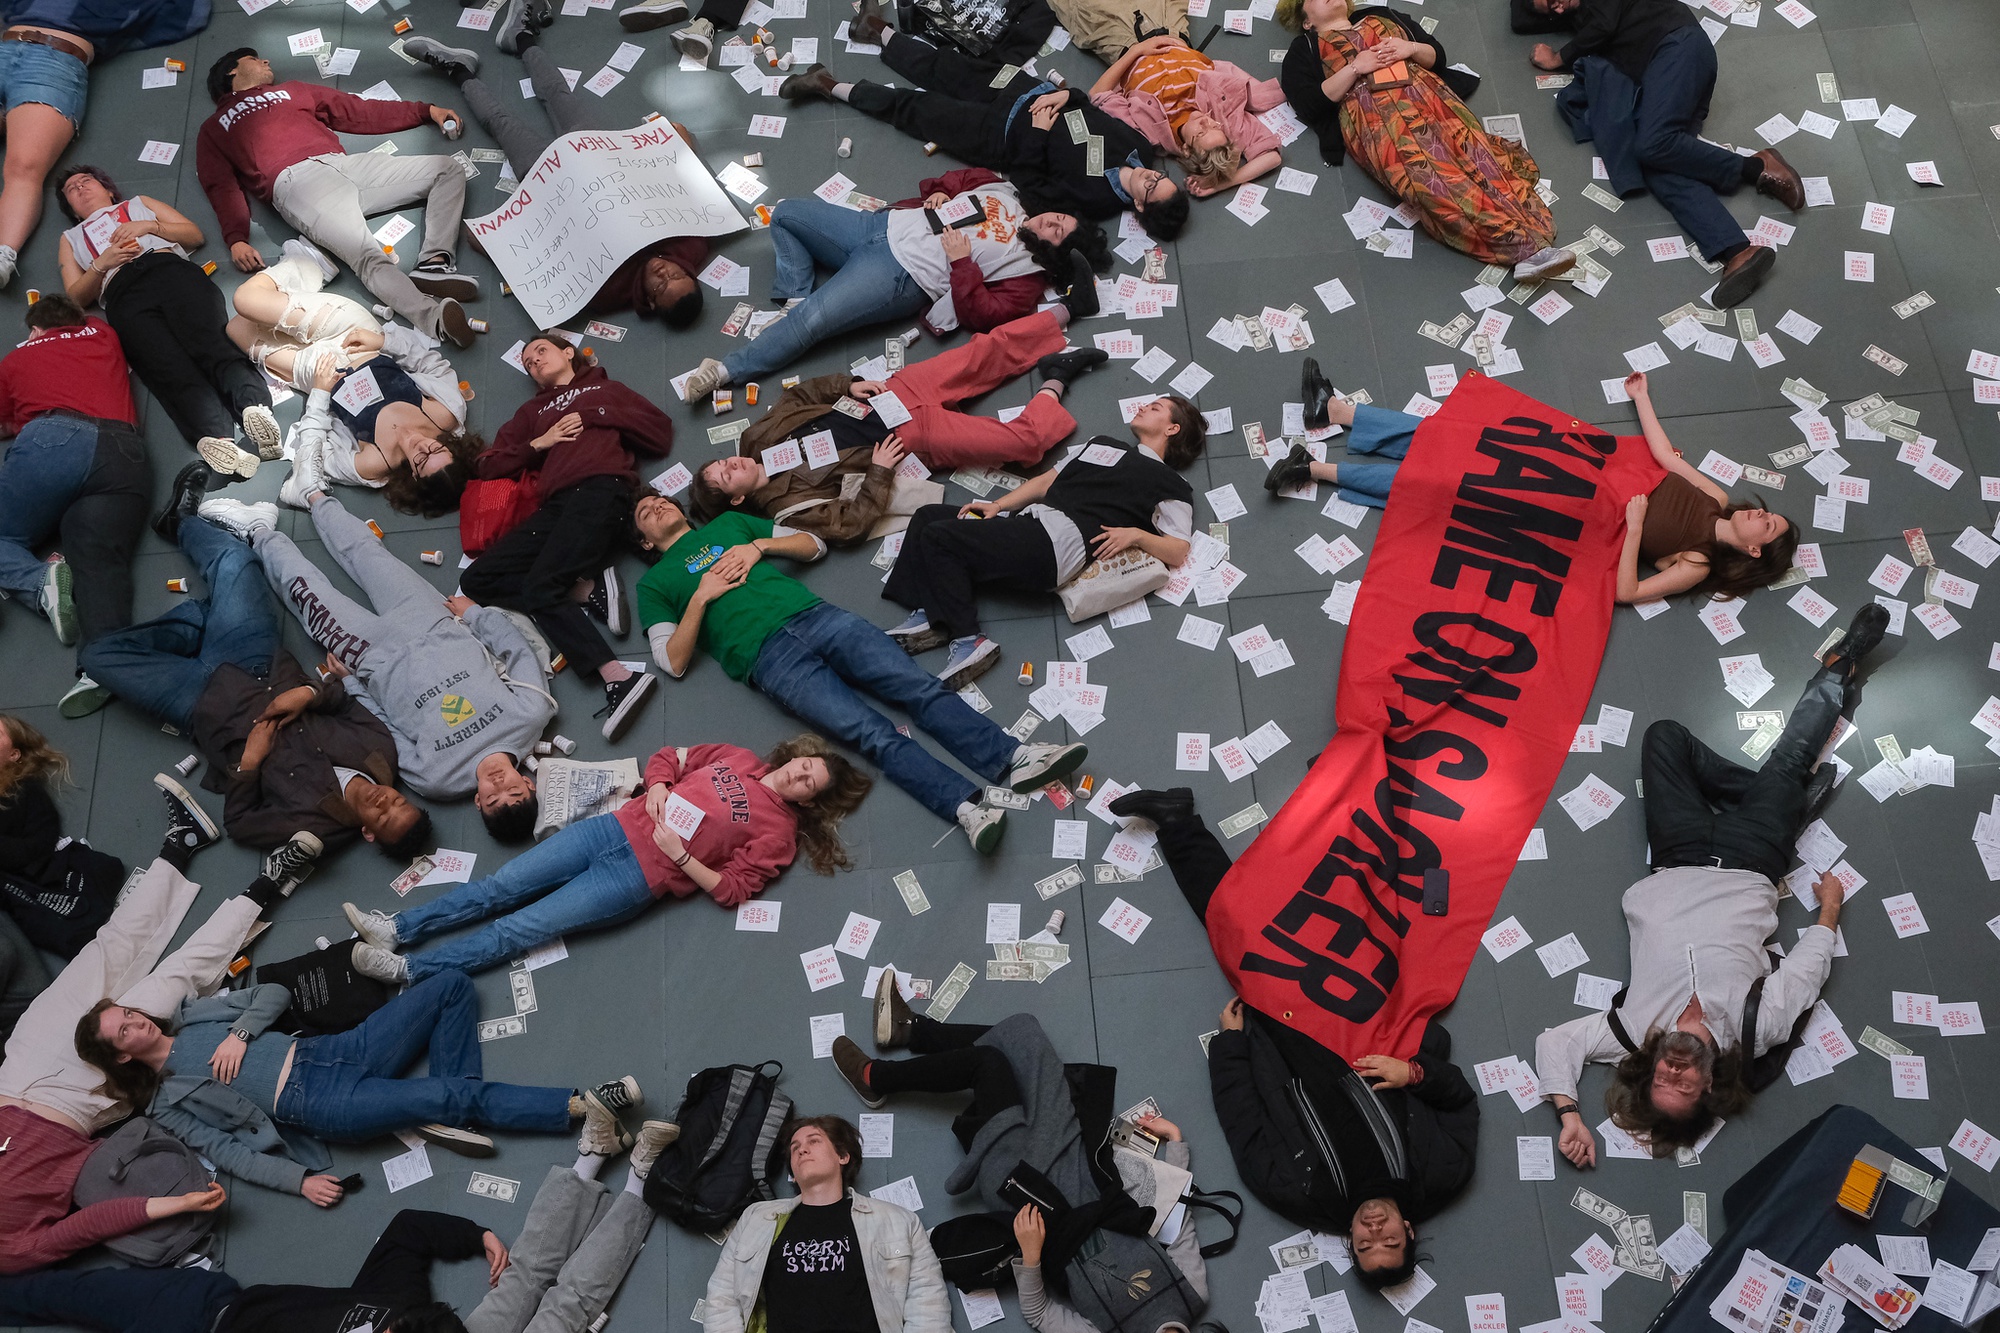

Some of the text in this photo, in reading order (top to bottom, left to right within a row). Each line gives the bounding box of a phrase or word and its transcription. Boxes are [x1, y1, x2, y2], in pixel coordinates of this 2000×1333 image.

[219, 90, 291, 132] HARVARD
[607, 151, 678, 168] AGASSIZ
[474, 127, 673, 236] TAKE THEM ALL DOWN!
[582, 171, 626, 203] ELIOT
[584, 183, 688, 230] WINTHROP
[509, 177, 575, 257] GRIFFIN
[629, 204, 725, 228] SACKLER
[524, 218, 576, 275] LEVERETT
[517, 251, 575, 292] LOWELL
[532, 242, 615, 315] MATHER
[812, 442, 829, 450] DOWN
[813, 446, 830, 454] THEIR
[772, 453, 780, 466] NAME
[782, 448, 790, 464] DOWN
[816, 450, 830, 458] NAME
[290, 576, 370, 670] HARVARD
[1385, 611, 1540, 729] ON
[414, 684, 442, 710] 1930
[434, 703, 504, 752] LEVERETT
[1221, 745, 1236, 755] TAKE
[1223, 749, 1240, 761] DOWN
[1225, 753, 1242, 764] THEIR
[1230, 759, 1245, 769] NAME
[711, 761, 750, 822] ASTINE
[668, 806, 681, 822] NAME
[674, 810, 686, 826] THEIR
[678, 812, 691, 828] DOWN
[684, 818, 696, 830] TAKE
[1111, 906, 1131, 929] SACKLER
[1889, 905, 1916, 916] SACKLER
[1123, 918, 1132, 926] ON
[1127, 918, 1143, 935] SHAME
[1899, 922, 1920, 931] SHAME
[850, 931, 867, 941] EACH
[852, 926, 869, 936] DEAD
[1504, 929, 1517, 944] DEAD
[850, 936, 862, 944] DAY
[1495, 935, 1504, 948] DAY
[1499, 931, 1512, 947] EACH
[807, 956, 836, 970] SACKLER
[816, 973, 838, 984] SHAME
[1916, 1006, 1922, 1015] ON
[1949, 1011, 1957, 1028] DEAD
[1955, 1010, 1963, 1028] EACH
[1820, 1031, 1836, 1043] NAME
[1823, 1037, 1840, 1049] THEIR
[1826, 1041, 1844, 1053] DOWN
[1832, 1048, 1846, 1058] TAKE
[1958, 1129, 1973, 1148] SHAME
[1970, 1139, 1978, 1149] ON
[1974, 1136, 1992, 1162] SACKLER
[787, 1255, 844, 1273] SWIM
[1588, 1249, 1602, 1264] DEAD
[1592, 1254, 1608, 1269] EACH
[1600, 1260, 1610, 1272] DAY
[1744, 1284, 1764, 1299] THEIR
[1748, 1277, 1768, 1292] NAME
[1738, 1297, 1756, 1310] TAKE
[1740, 1290, 1762, 1306] DOWN
